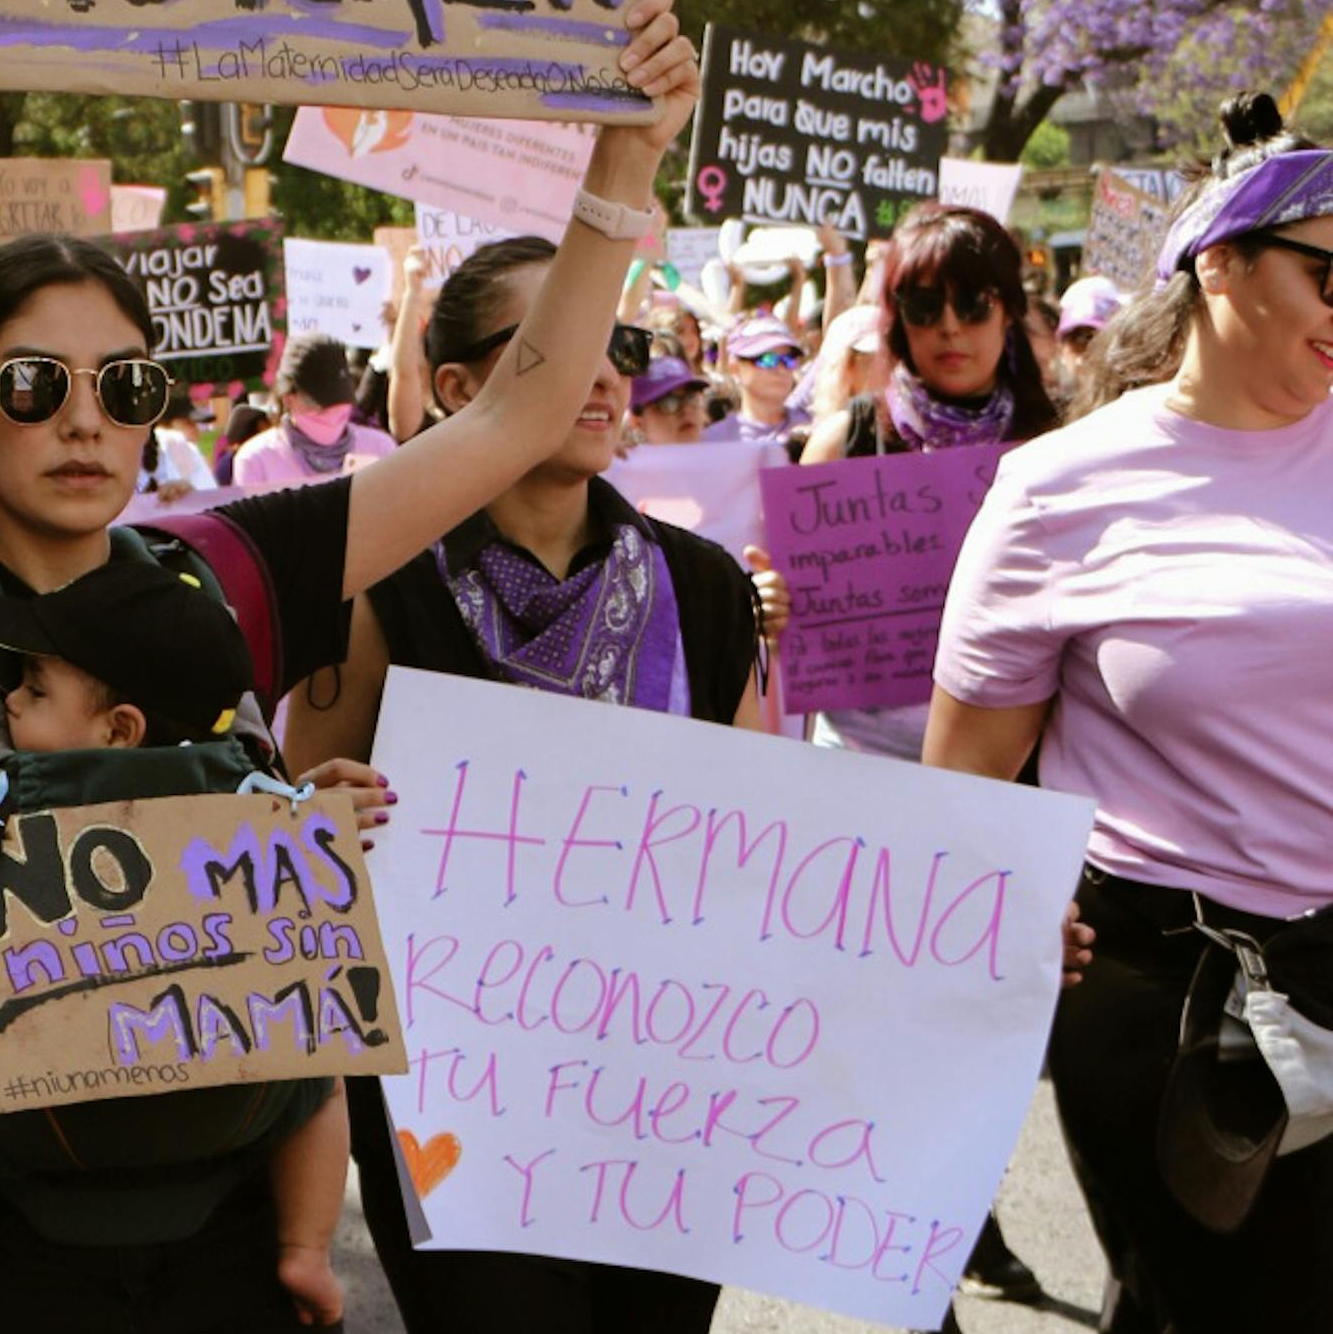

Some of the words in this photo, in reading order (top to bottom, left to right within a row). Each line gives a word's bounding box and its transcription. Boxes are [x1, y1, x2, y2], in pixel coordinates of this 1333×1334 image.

[801, 52, 915, 105] Marcho
[857, 116, 917, 152] mis
[718, 127, 793, 175] hijas
[805, 144, 855, 181] NO
[862, 153, 937, 197] falten
[743, 176, 866, 234] NUNCA
[146, 278, 199, 308] NO
[151, 299, 273, 351] ONDENA
[790, 468, 943, 535] Juntas
[790, 580, 883, 617] Juntas
[177, 812, 358, 916] MAS
[3, 913, 234, 995] niños
[266, 908, 365, 965] sin
[3, 1063, 191, 1101] #niunamenos
[502, 1148, 558, 1229] Y
[732, 1171, 970, 1296] PODER
